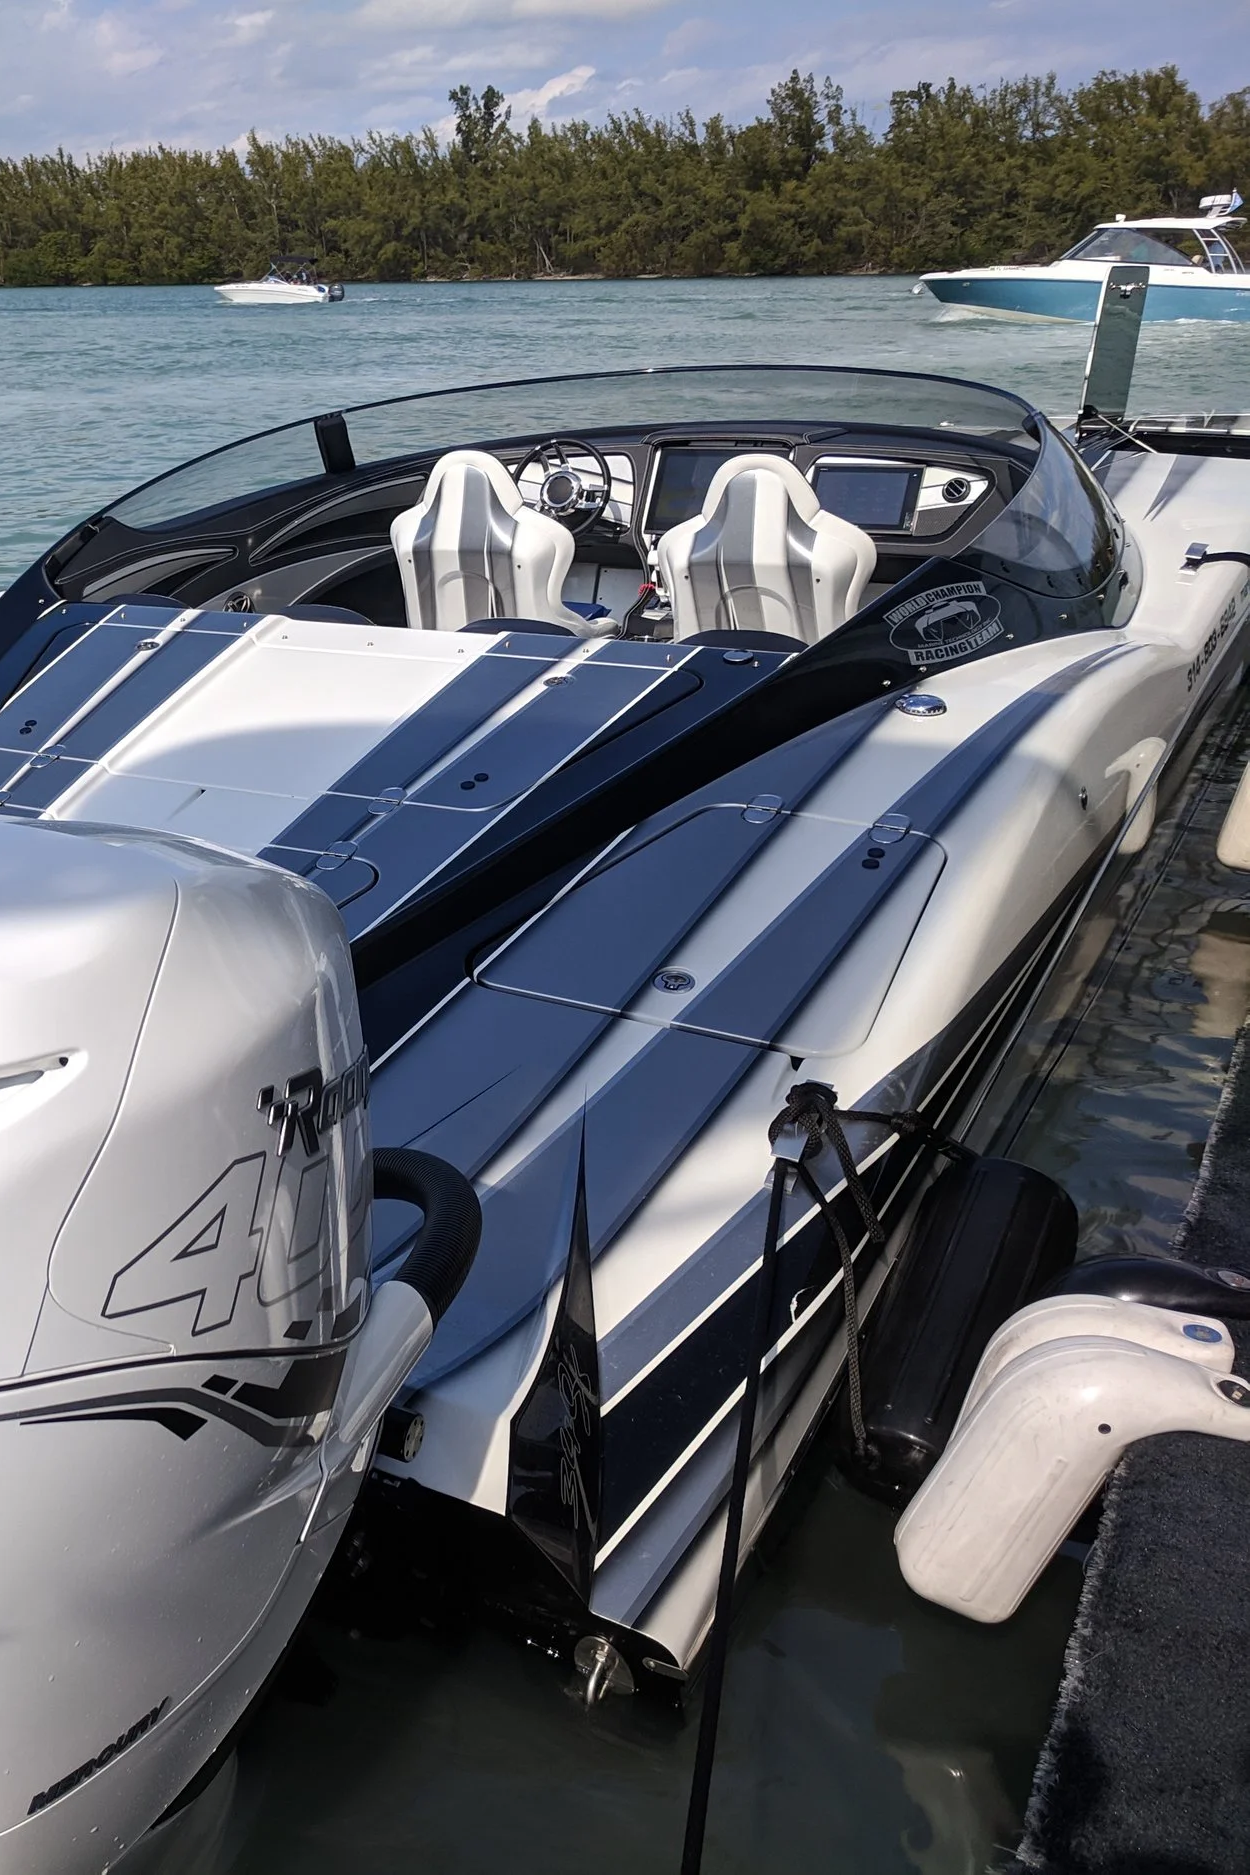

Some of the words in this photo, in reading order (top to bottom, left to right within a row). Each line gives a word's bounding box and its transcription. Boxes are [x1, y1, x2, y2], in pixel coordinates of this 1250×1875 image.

[888, 596, 927, 624] WORLD
[926, 584, 981, 602] CHAMPION
[914, 641, 968, 661] RACING
[968, 623, 1000, 649] TEAM
[26, 1695, 171, 1816] MERCURY
